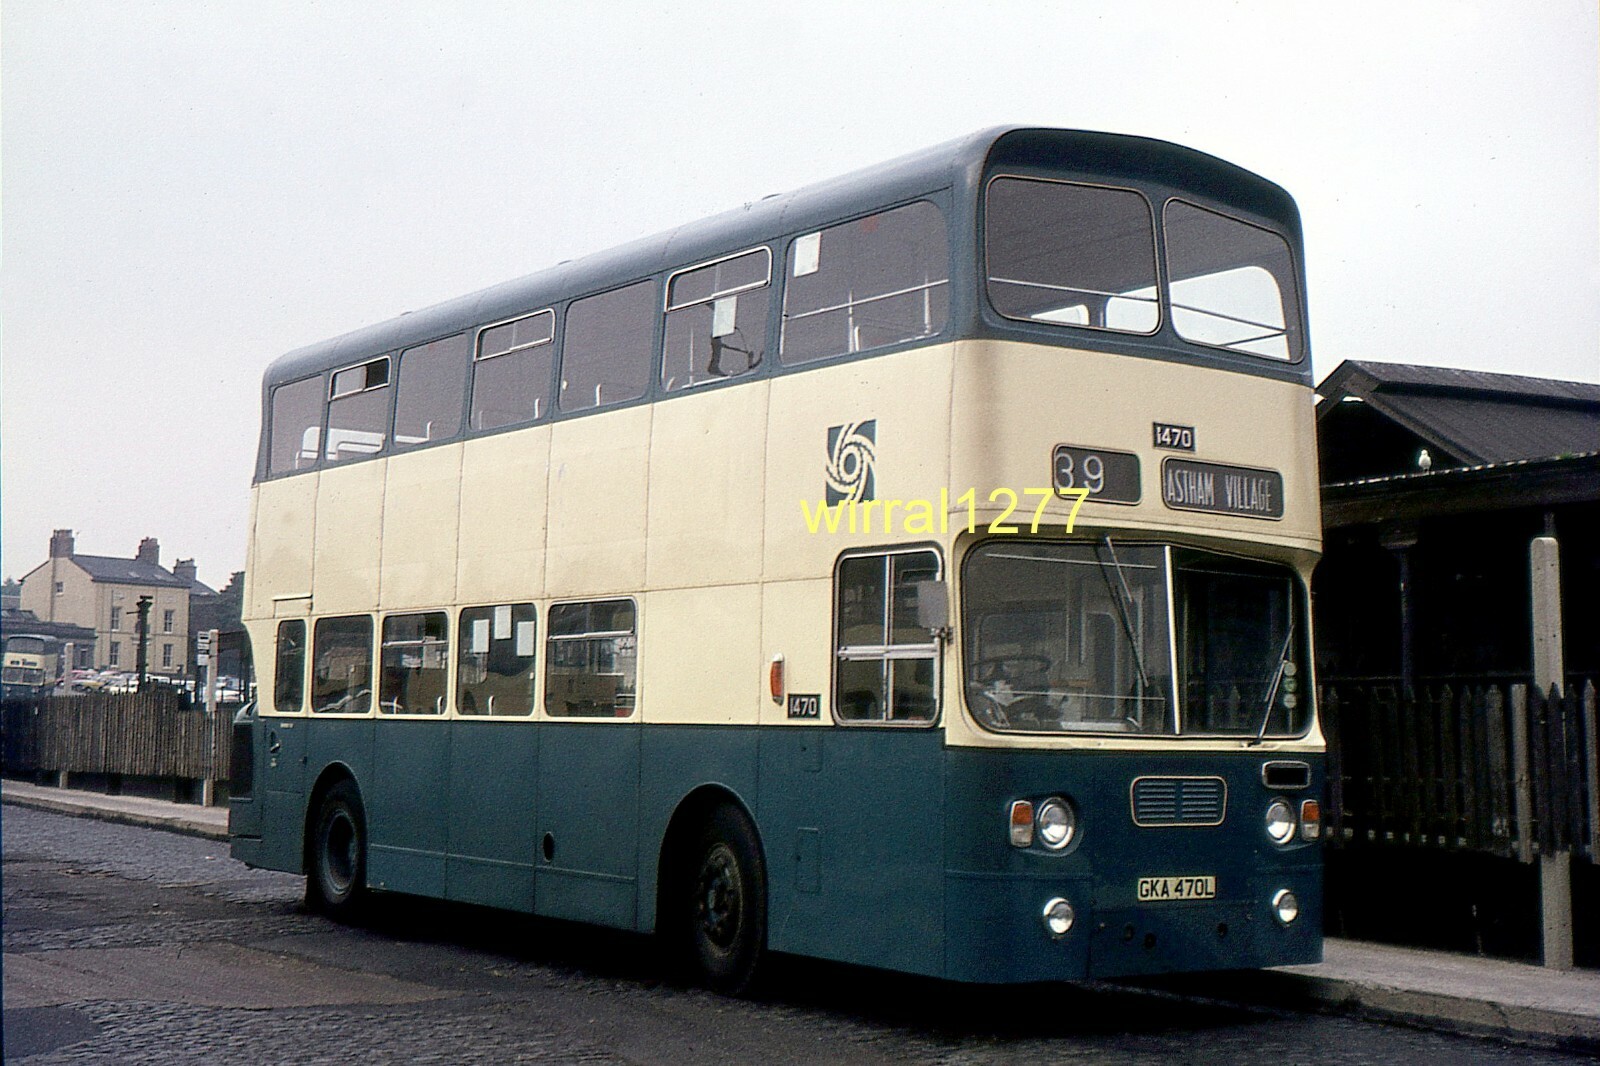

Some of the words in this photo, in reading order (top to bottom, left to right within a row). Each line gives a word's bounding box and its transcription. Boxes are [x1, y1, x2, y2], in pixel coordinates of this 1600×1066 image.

[1156, 427, 1192, 447] 1470
[1055, 453, 1104, 493] 39
[1167, 469, 1215, 505] ASTHAM
[1225, 475, 1271, 511] VILLAGE
[790, 698, 817, 715] 1470
[1140, 880, 1169, 897] GKA
[1175, 879, 1213, 896] 470L
